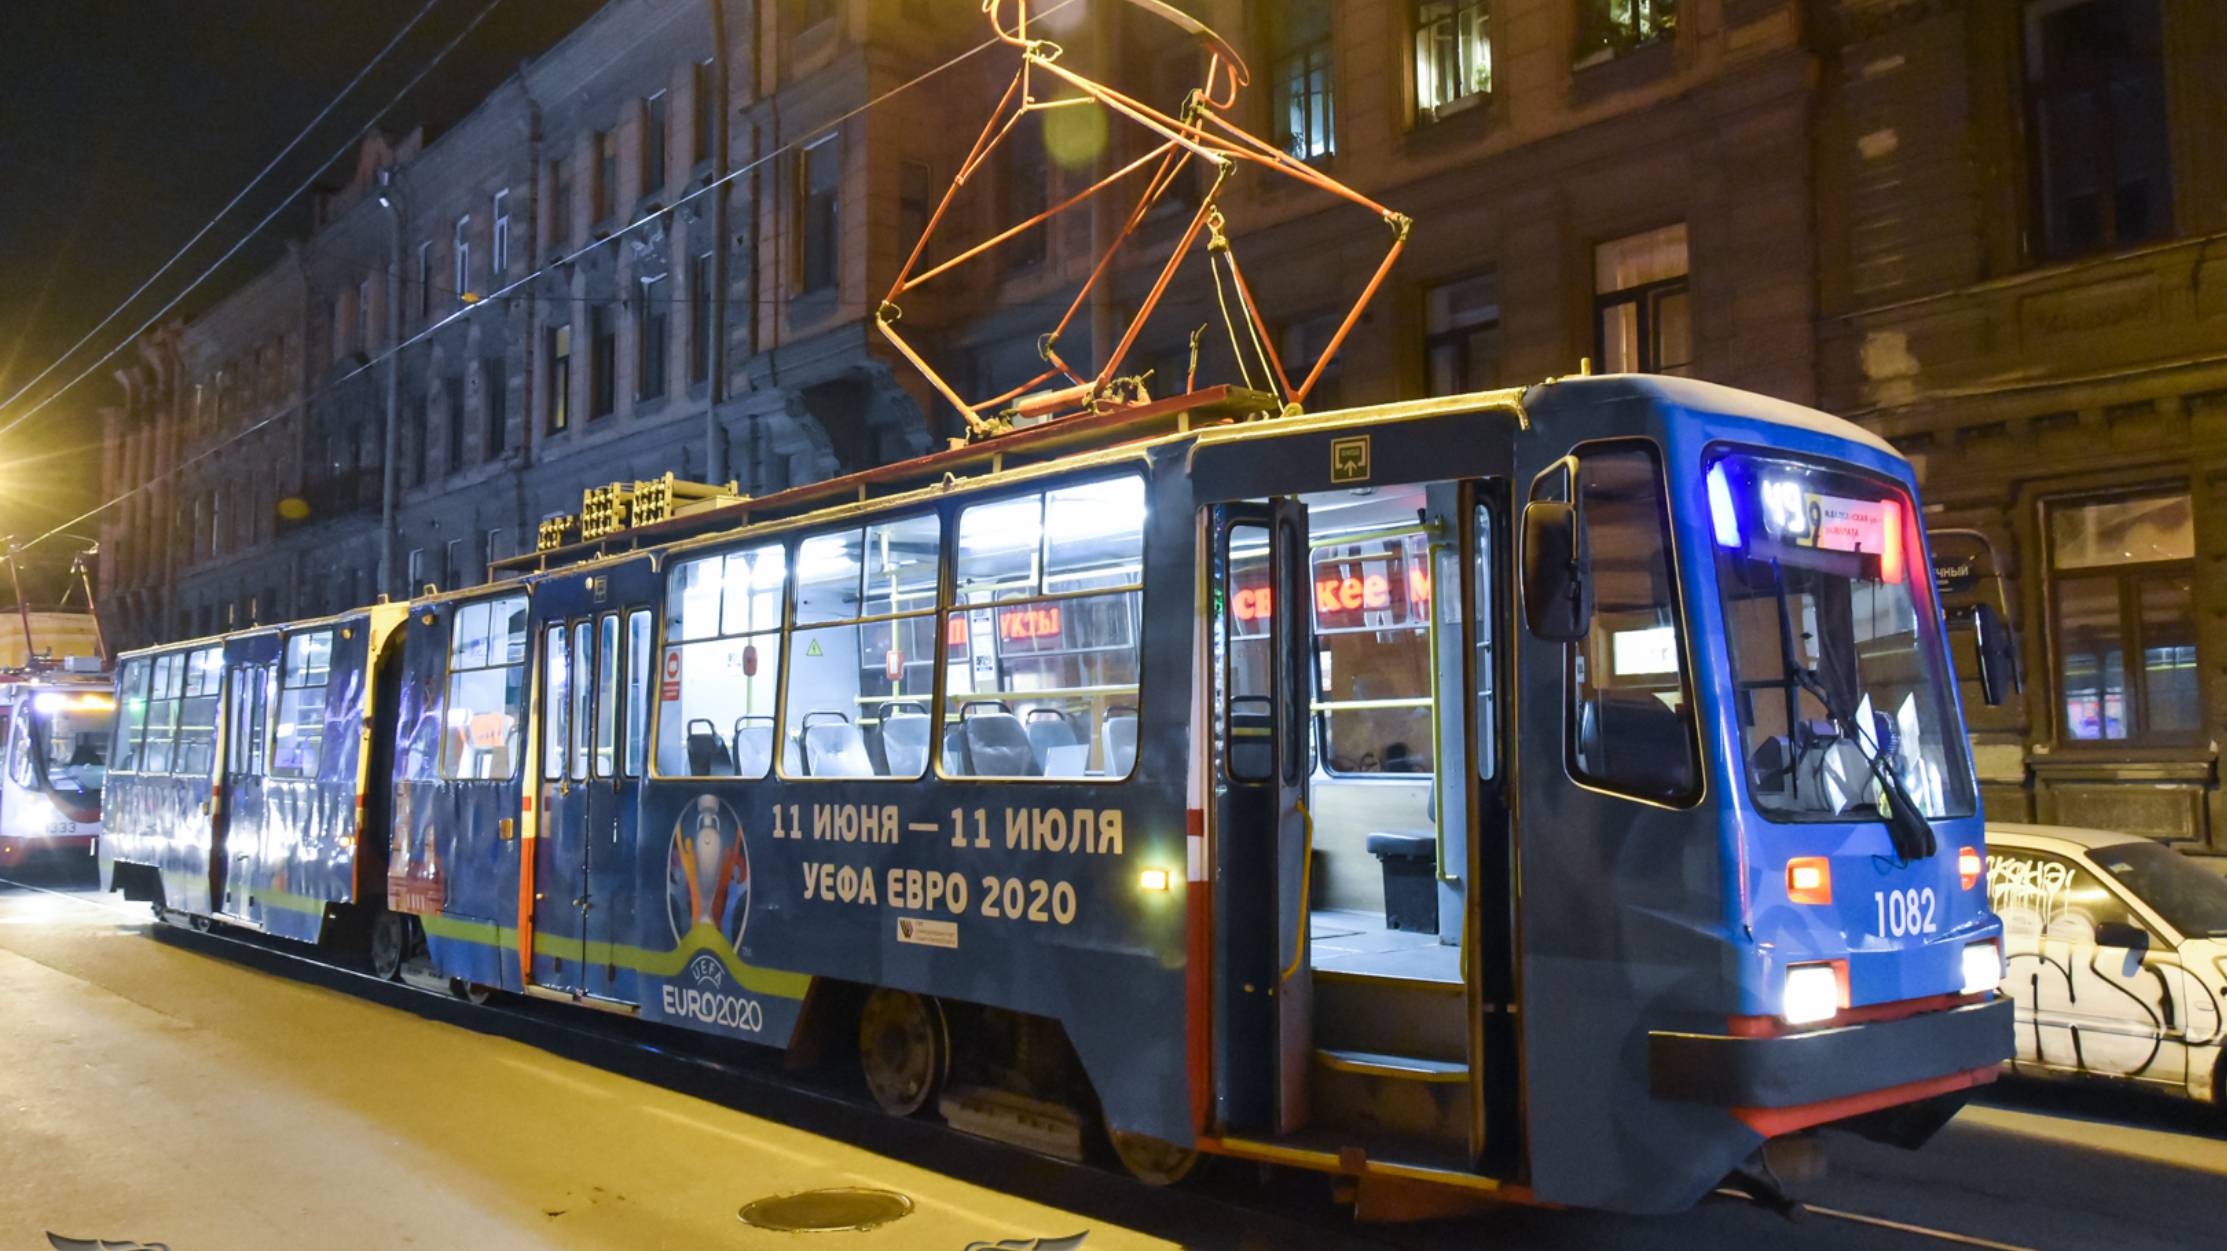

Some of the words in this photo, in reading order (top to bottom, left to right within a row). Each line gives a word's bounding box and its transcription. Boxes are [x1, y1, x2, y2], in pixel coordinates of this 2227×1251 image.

[1935, 564, 1969, 578] ЧНЫЙ
[772, 803, 802, 840] 11
[812, 804, 899, 845] ИЮНЯ
[950, 807, 990, 849] 11
[1005, 806, 1124, 855] ИЮЛЯ
[802, 861, 878, 906] УЕФА
[886, 868, 968, 914] ЕВРО
[981, 876, 1078, 925] 2020
[1874, 886, 1937, 939] 1082
[691, 959, 723, 986] UEFA
